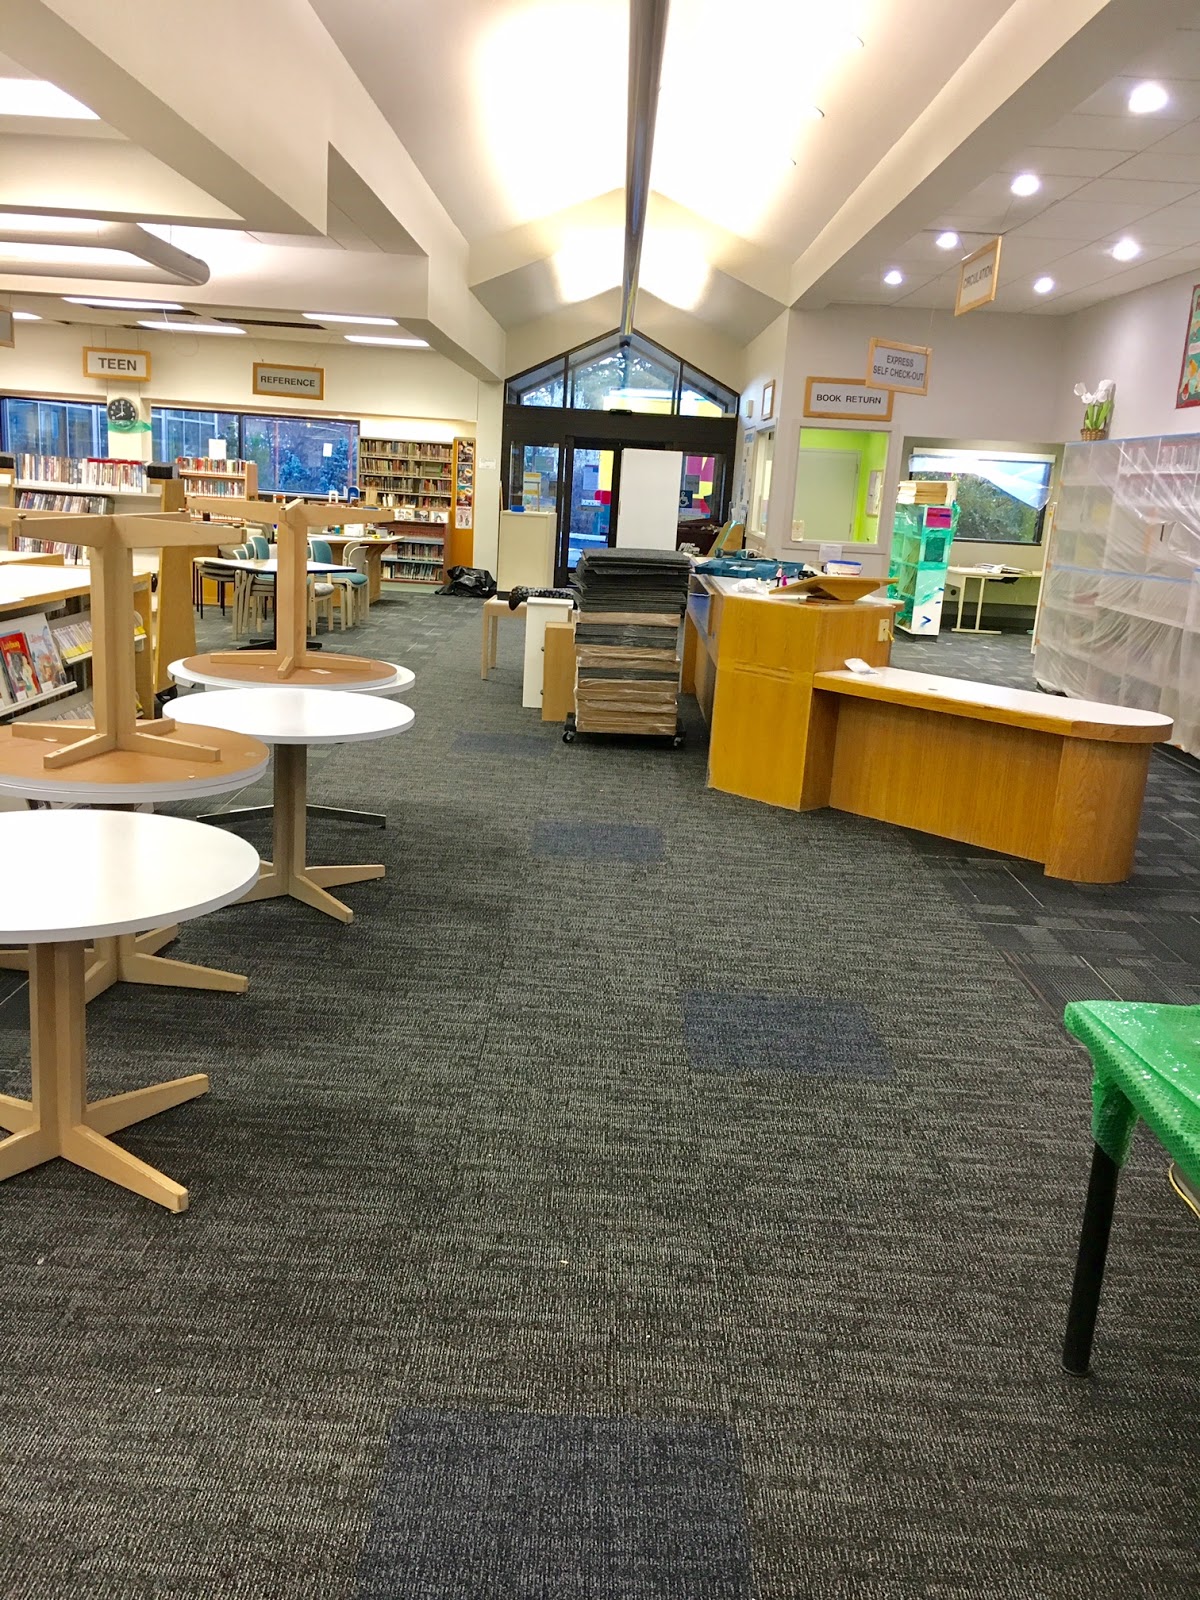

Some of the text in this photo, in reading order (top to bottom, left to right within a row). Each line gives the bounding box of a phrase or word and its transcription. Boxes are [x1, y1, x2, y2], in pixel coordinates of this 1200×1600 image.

[98, 357, 136, 371] TEEN
[886, 355, 914, 367] EXPRESS
[873, 365, 924, 382] SELF CHECK-OUT
[260, 375, 315, 387] REFERENCE
[816, 393, 882, 404] BOOK RETURN
